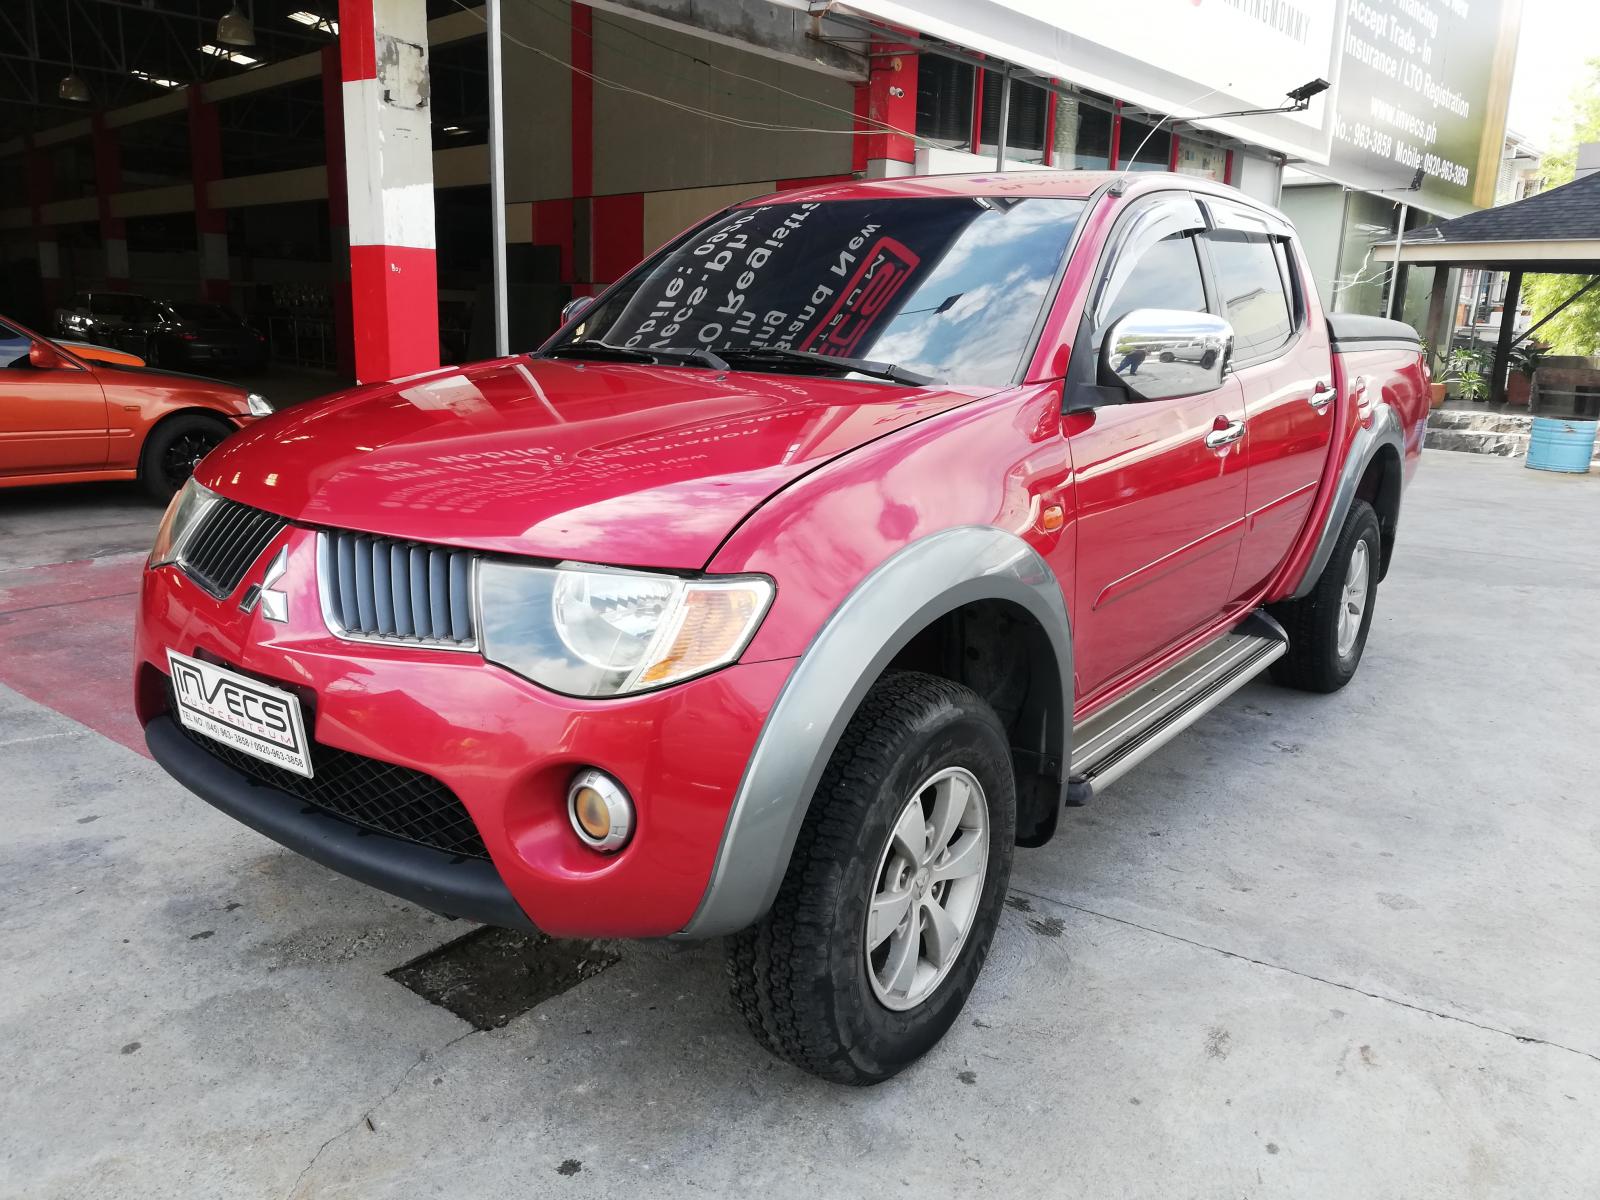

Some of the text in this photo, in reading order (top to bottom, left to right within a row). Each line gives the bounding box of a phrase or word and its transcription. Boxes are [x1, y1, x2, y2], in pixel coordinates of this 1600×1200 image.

[1350, 0, 1388, 39] Accept
[1390, 15, 1416, 54] Trade
[1422, 38, 1432, 64] In
[1393, 0, 1439, 39] nancing
[1345, 25, 1397, 79] Insurance
[1404, 61, 1423, 92] LTO
[1424, 72, 1470, 118] Registration
[1371, 96, 1437, 146] www.invecs.ph
[1354, 122, 1392, 158] 963-3858
[1395, 140, 1423, 169] Mobile:
[1424, 153, 1469, 186] 0920-963-3858
[183, 696, 293, 745] AUTOCENTRUM
